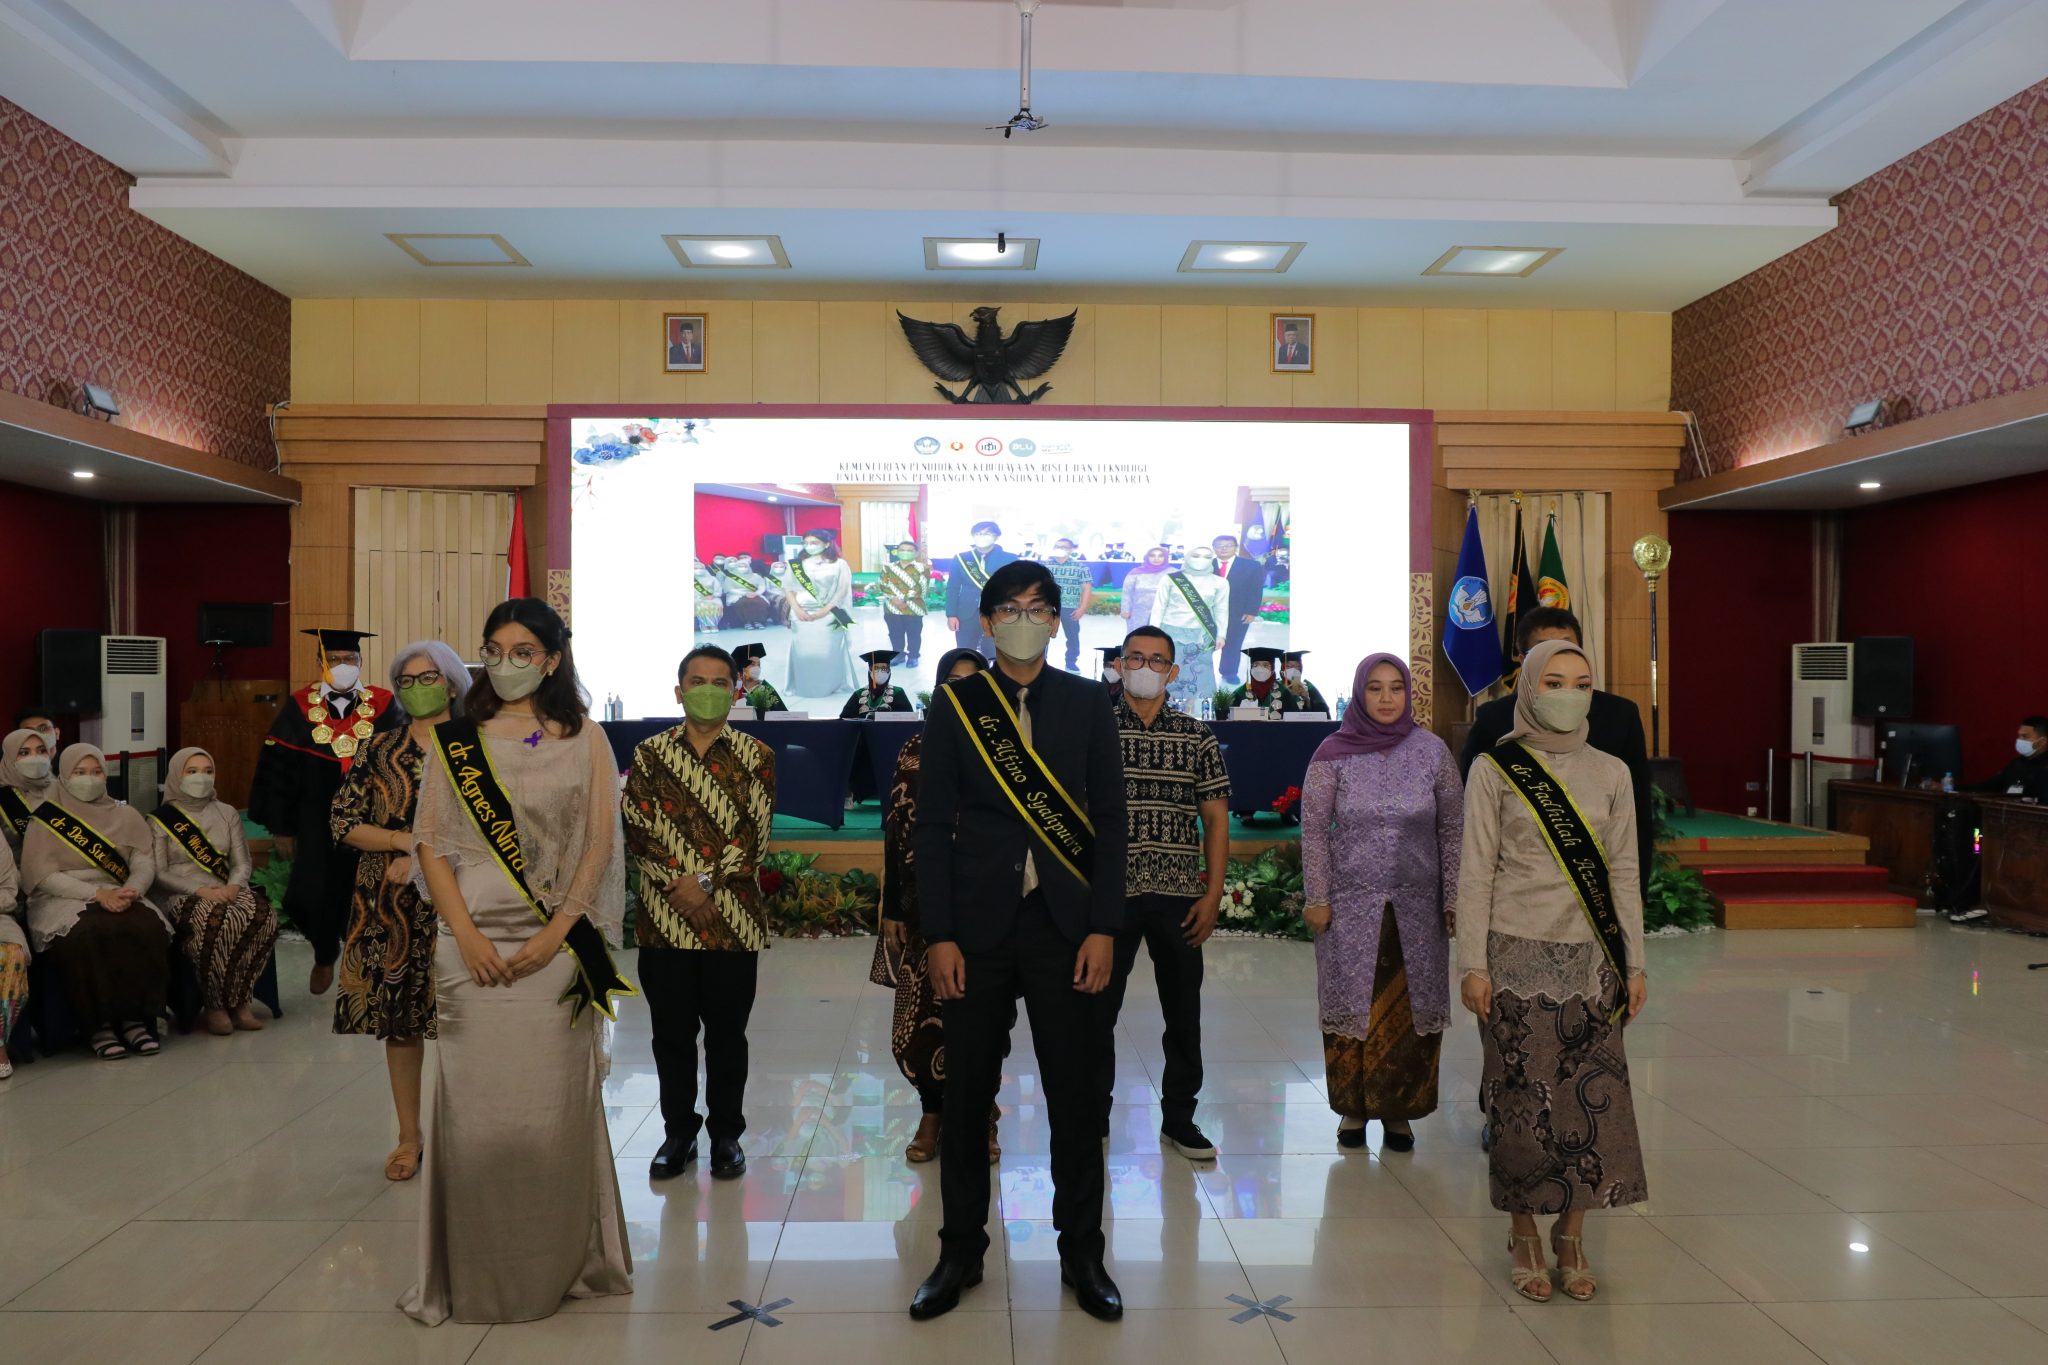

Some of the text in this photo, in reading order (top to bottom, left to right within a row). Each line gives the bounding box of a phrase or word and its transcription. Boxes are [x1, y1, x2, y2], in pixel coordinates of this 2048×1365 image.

[50, 817, 67, 830] dr.
[67, 825, 89, 847] Dea
[173, 822, 212, 864] dr. Widya
[448, 741, 528, 873] dr. Agnes Nina
[978, 714, 1084, 856] dr. Alfino Syahputra
[1510, 764, 1532, 782] dr.
[1527, 781, 1582, 847] Fadhilah
[1572, 858, 1607, 918] Azzahra
